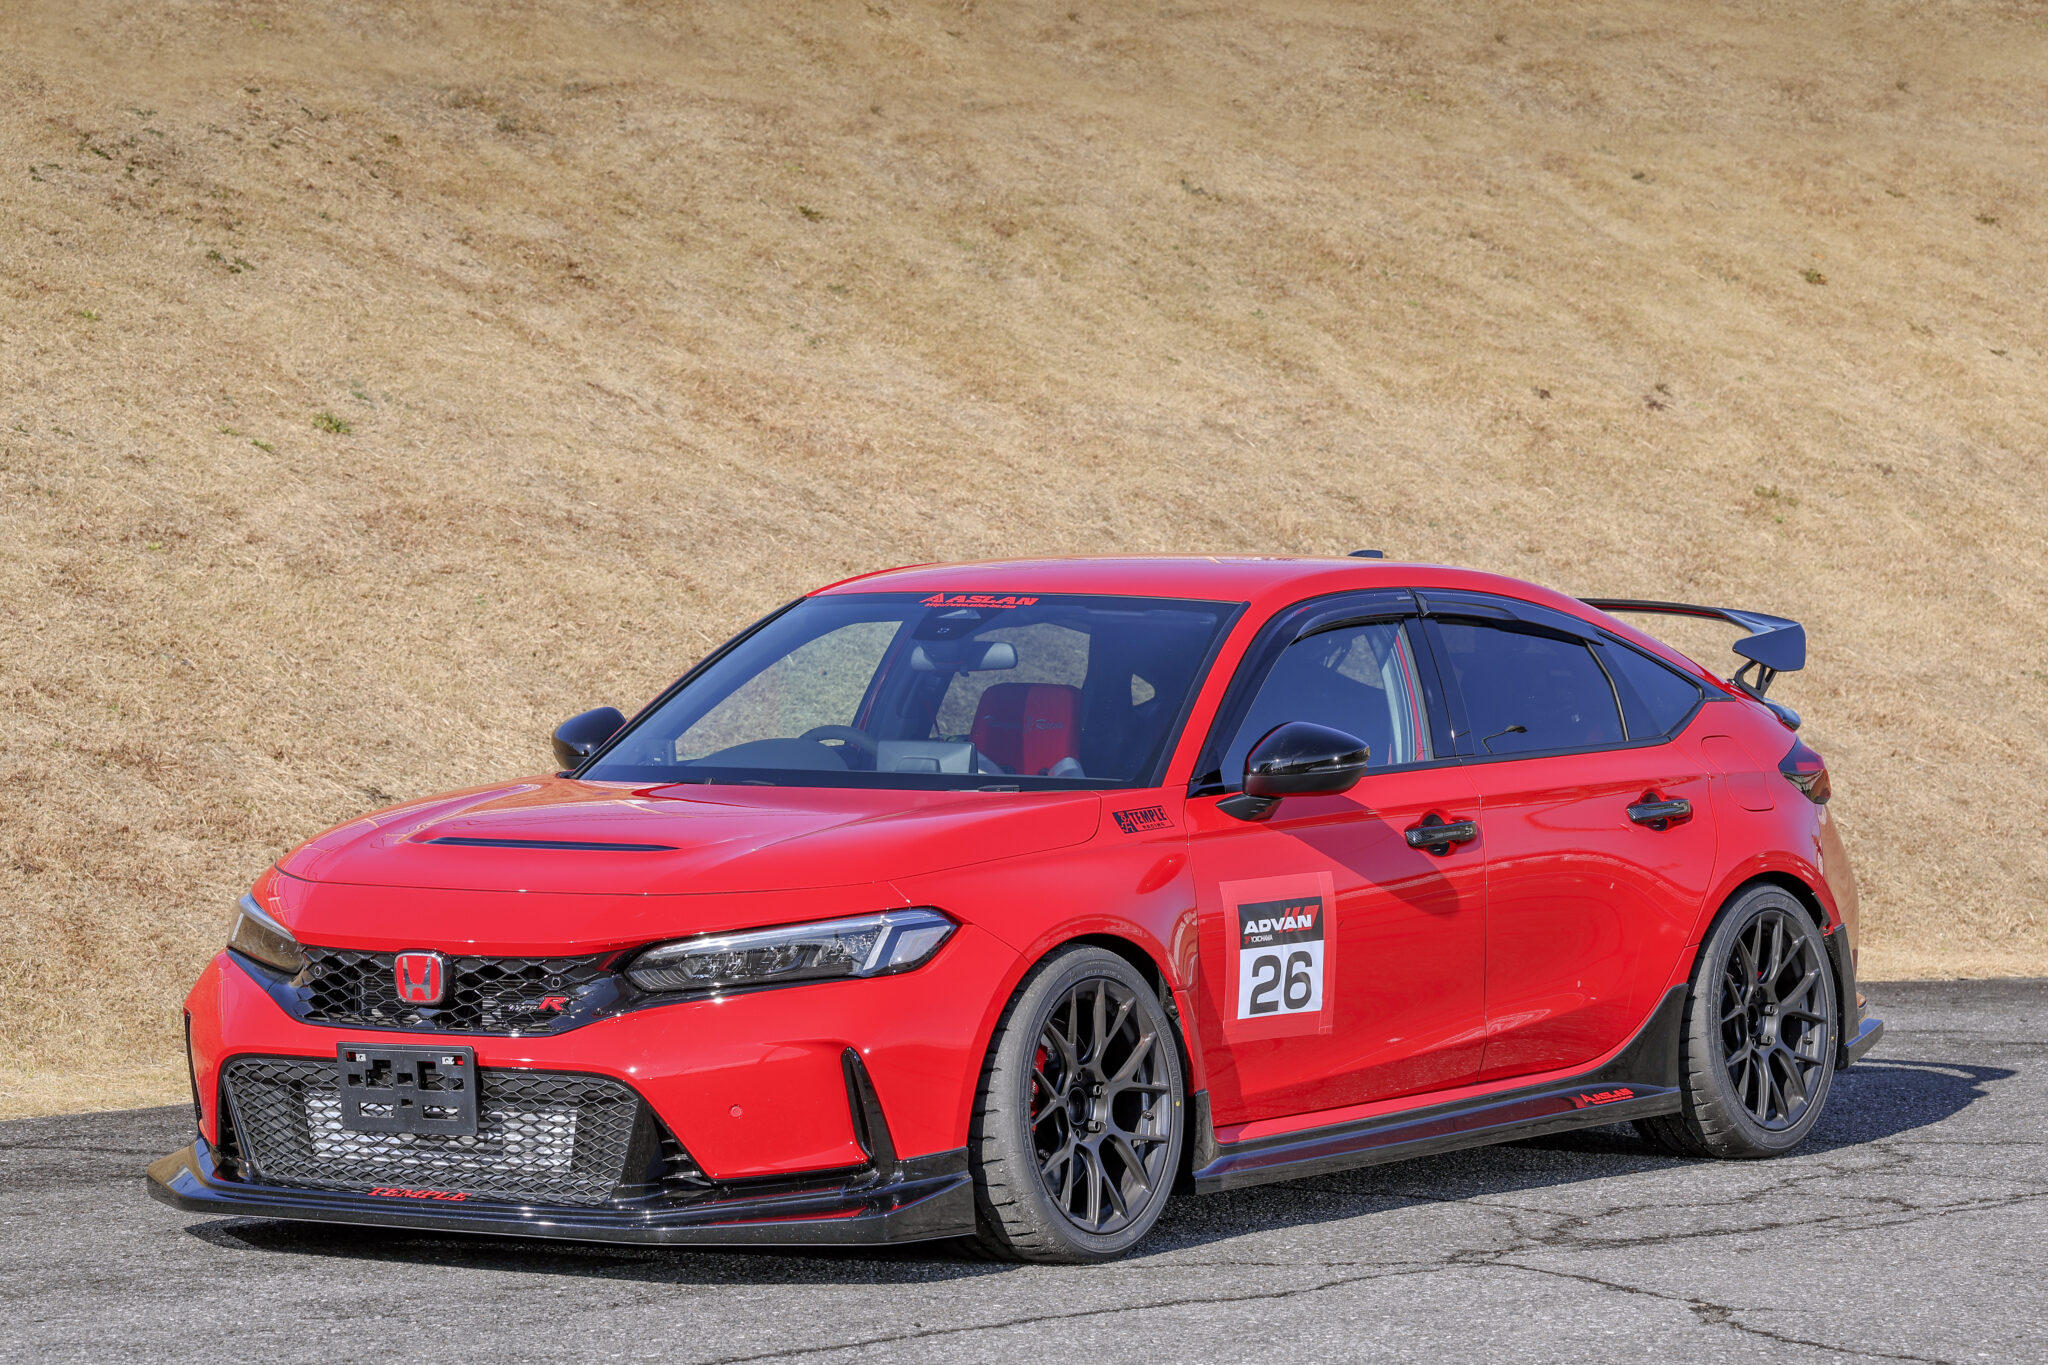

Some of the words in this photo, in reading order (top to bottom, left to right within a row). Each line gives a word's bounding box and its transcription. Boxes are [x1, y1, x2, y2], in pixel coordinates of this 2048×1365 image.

[945, 595, 1039, 606] ASLAN
[1128, 807, 1168, 825] TEMPLE
[1243, 914, 1312, 935] ADVAN
[1249, 950, 1313, 1015] 26
[367, 1187, 473, 1202] TEMPLE
